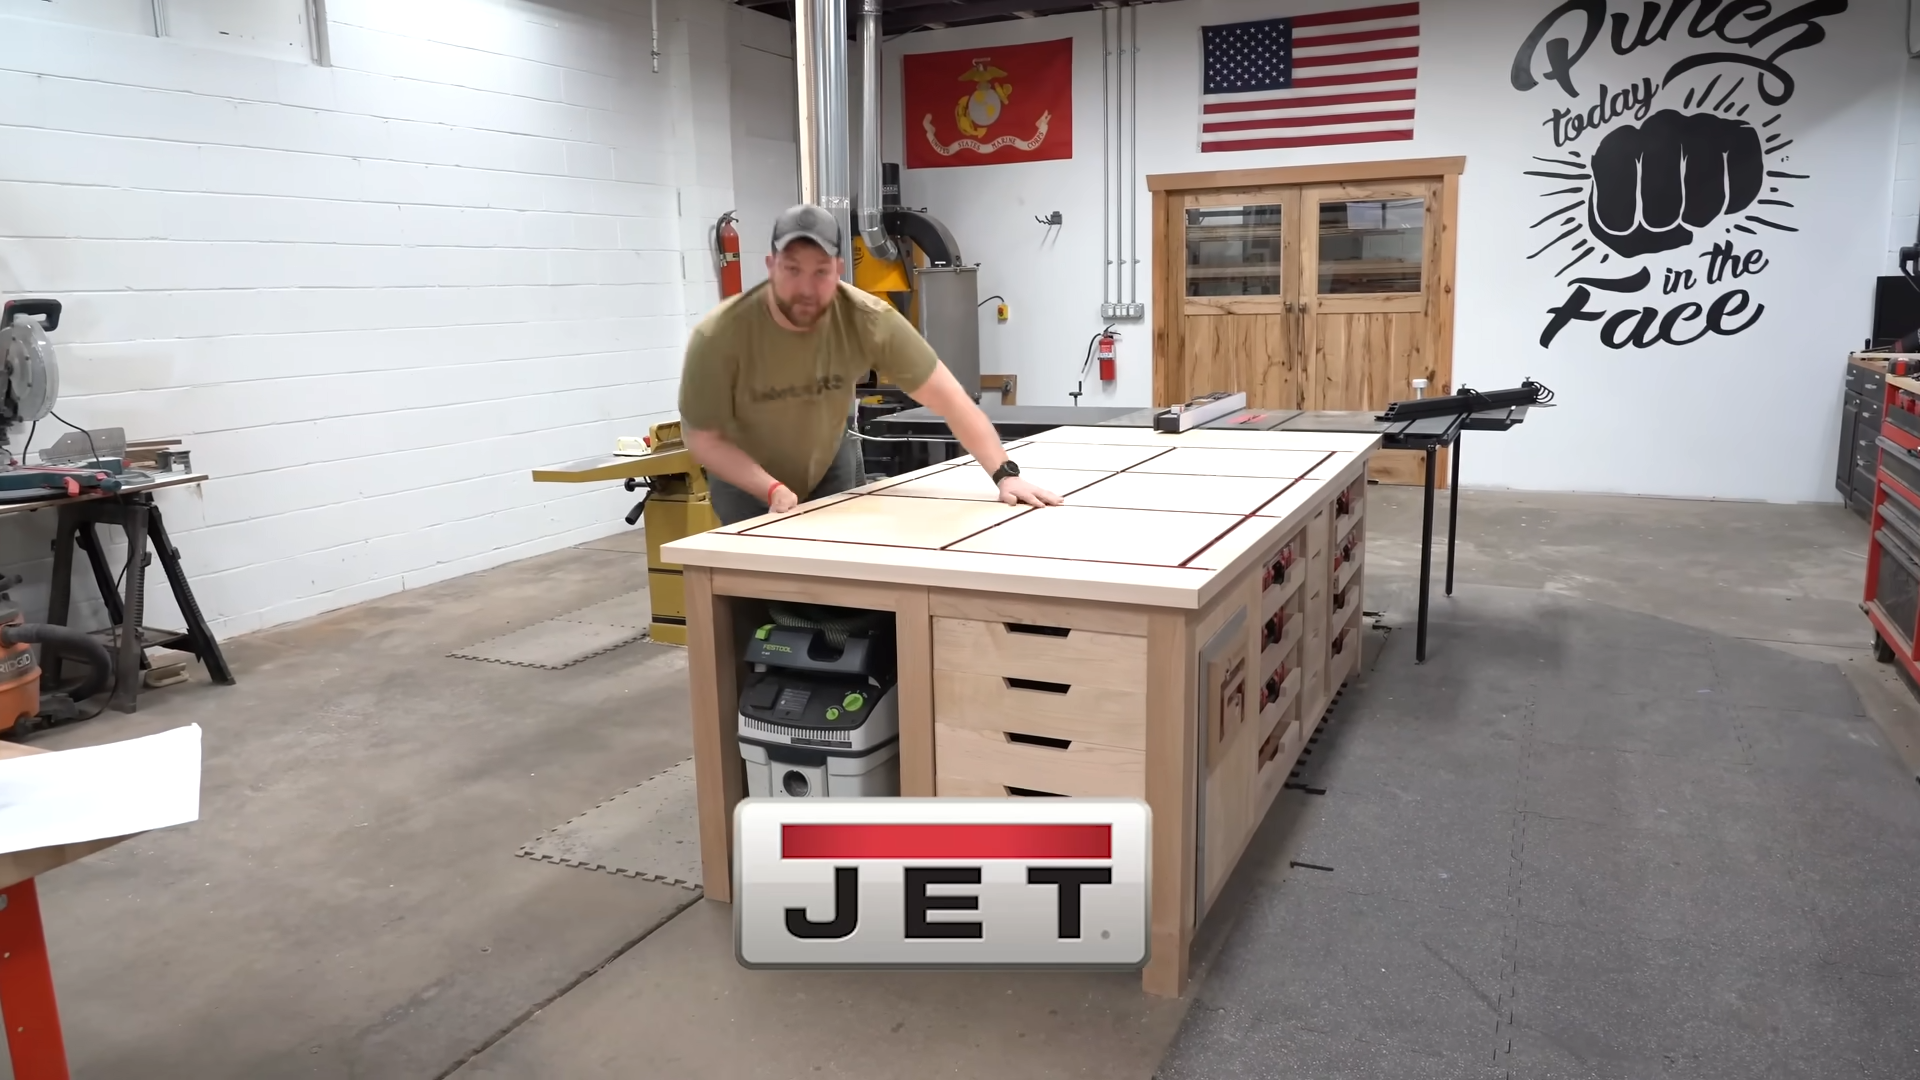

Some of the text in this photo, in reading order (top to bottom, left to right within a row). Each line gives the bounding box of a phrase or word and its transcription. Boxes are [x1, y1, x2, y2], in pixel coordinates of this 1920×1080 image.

[1543, 77, 1659, 147] today
[931, 131, 1045, 155] UNITED STATES MARINE CORPS
[1663, 240, 1769, 295] in the
[1539, 266, 1765, 349] Face
[763, 644, 792, 653] FESTOOL
